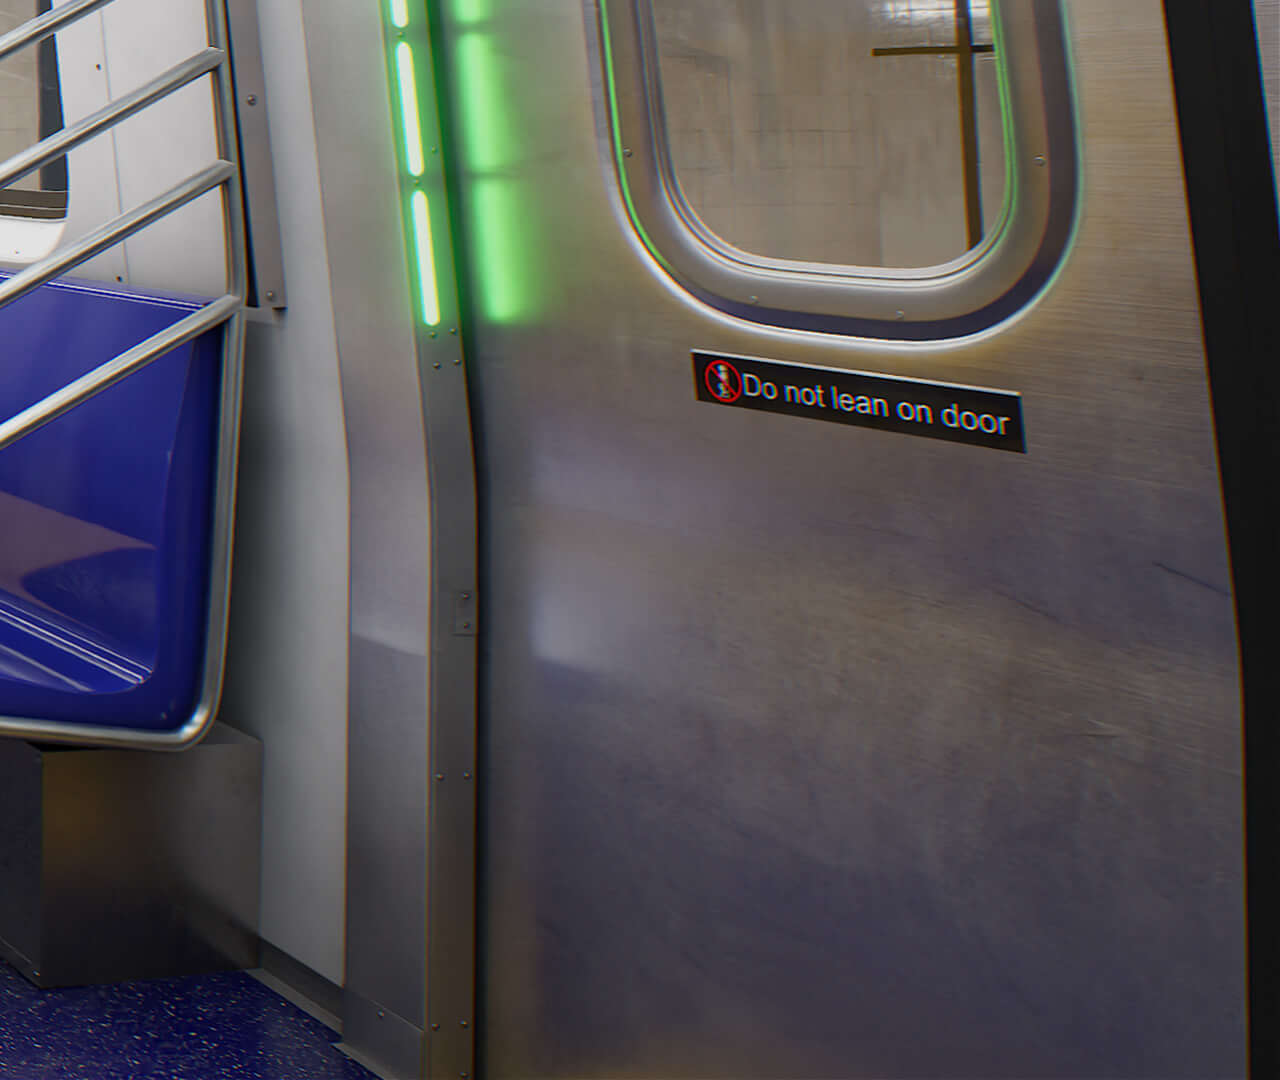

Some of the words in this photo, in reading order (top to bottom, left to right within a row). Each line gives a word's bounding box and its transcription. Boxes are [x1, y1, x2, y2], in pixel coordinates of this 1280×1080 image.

[740, 372, 778, 400] Do
[784, 384, 827, 408] not
[831, 386, 890, 417] lean
[896, 401, 934, 424] on
[940, 403, 1011, 435] door
